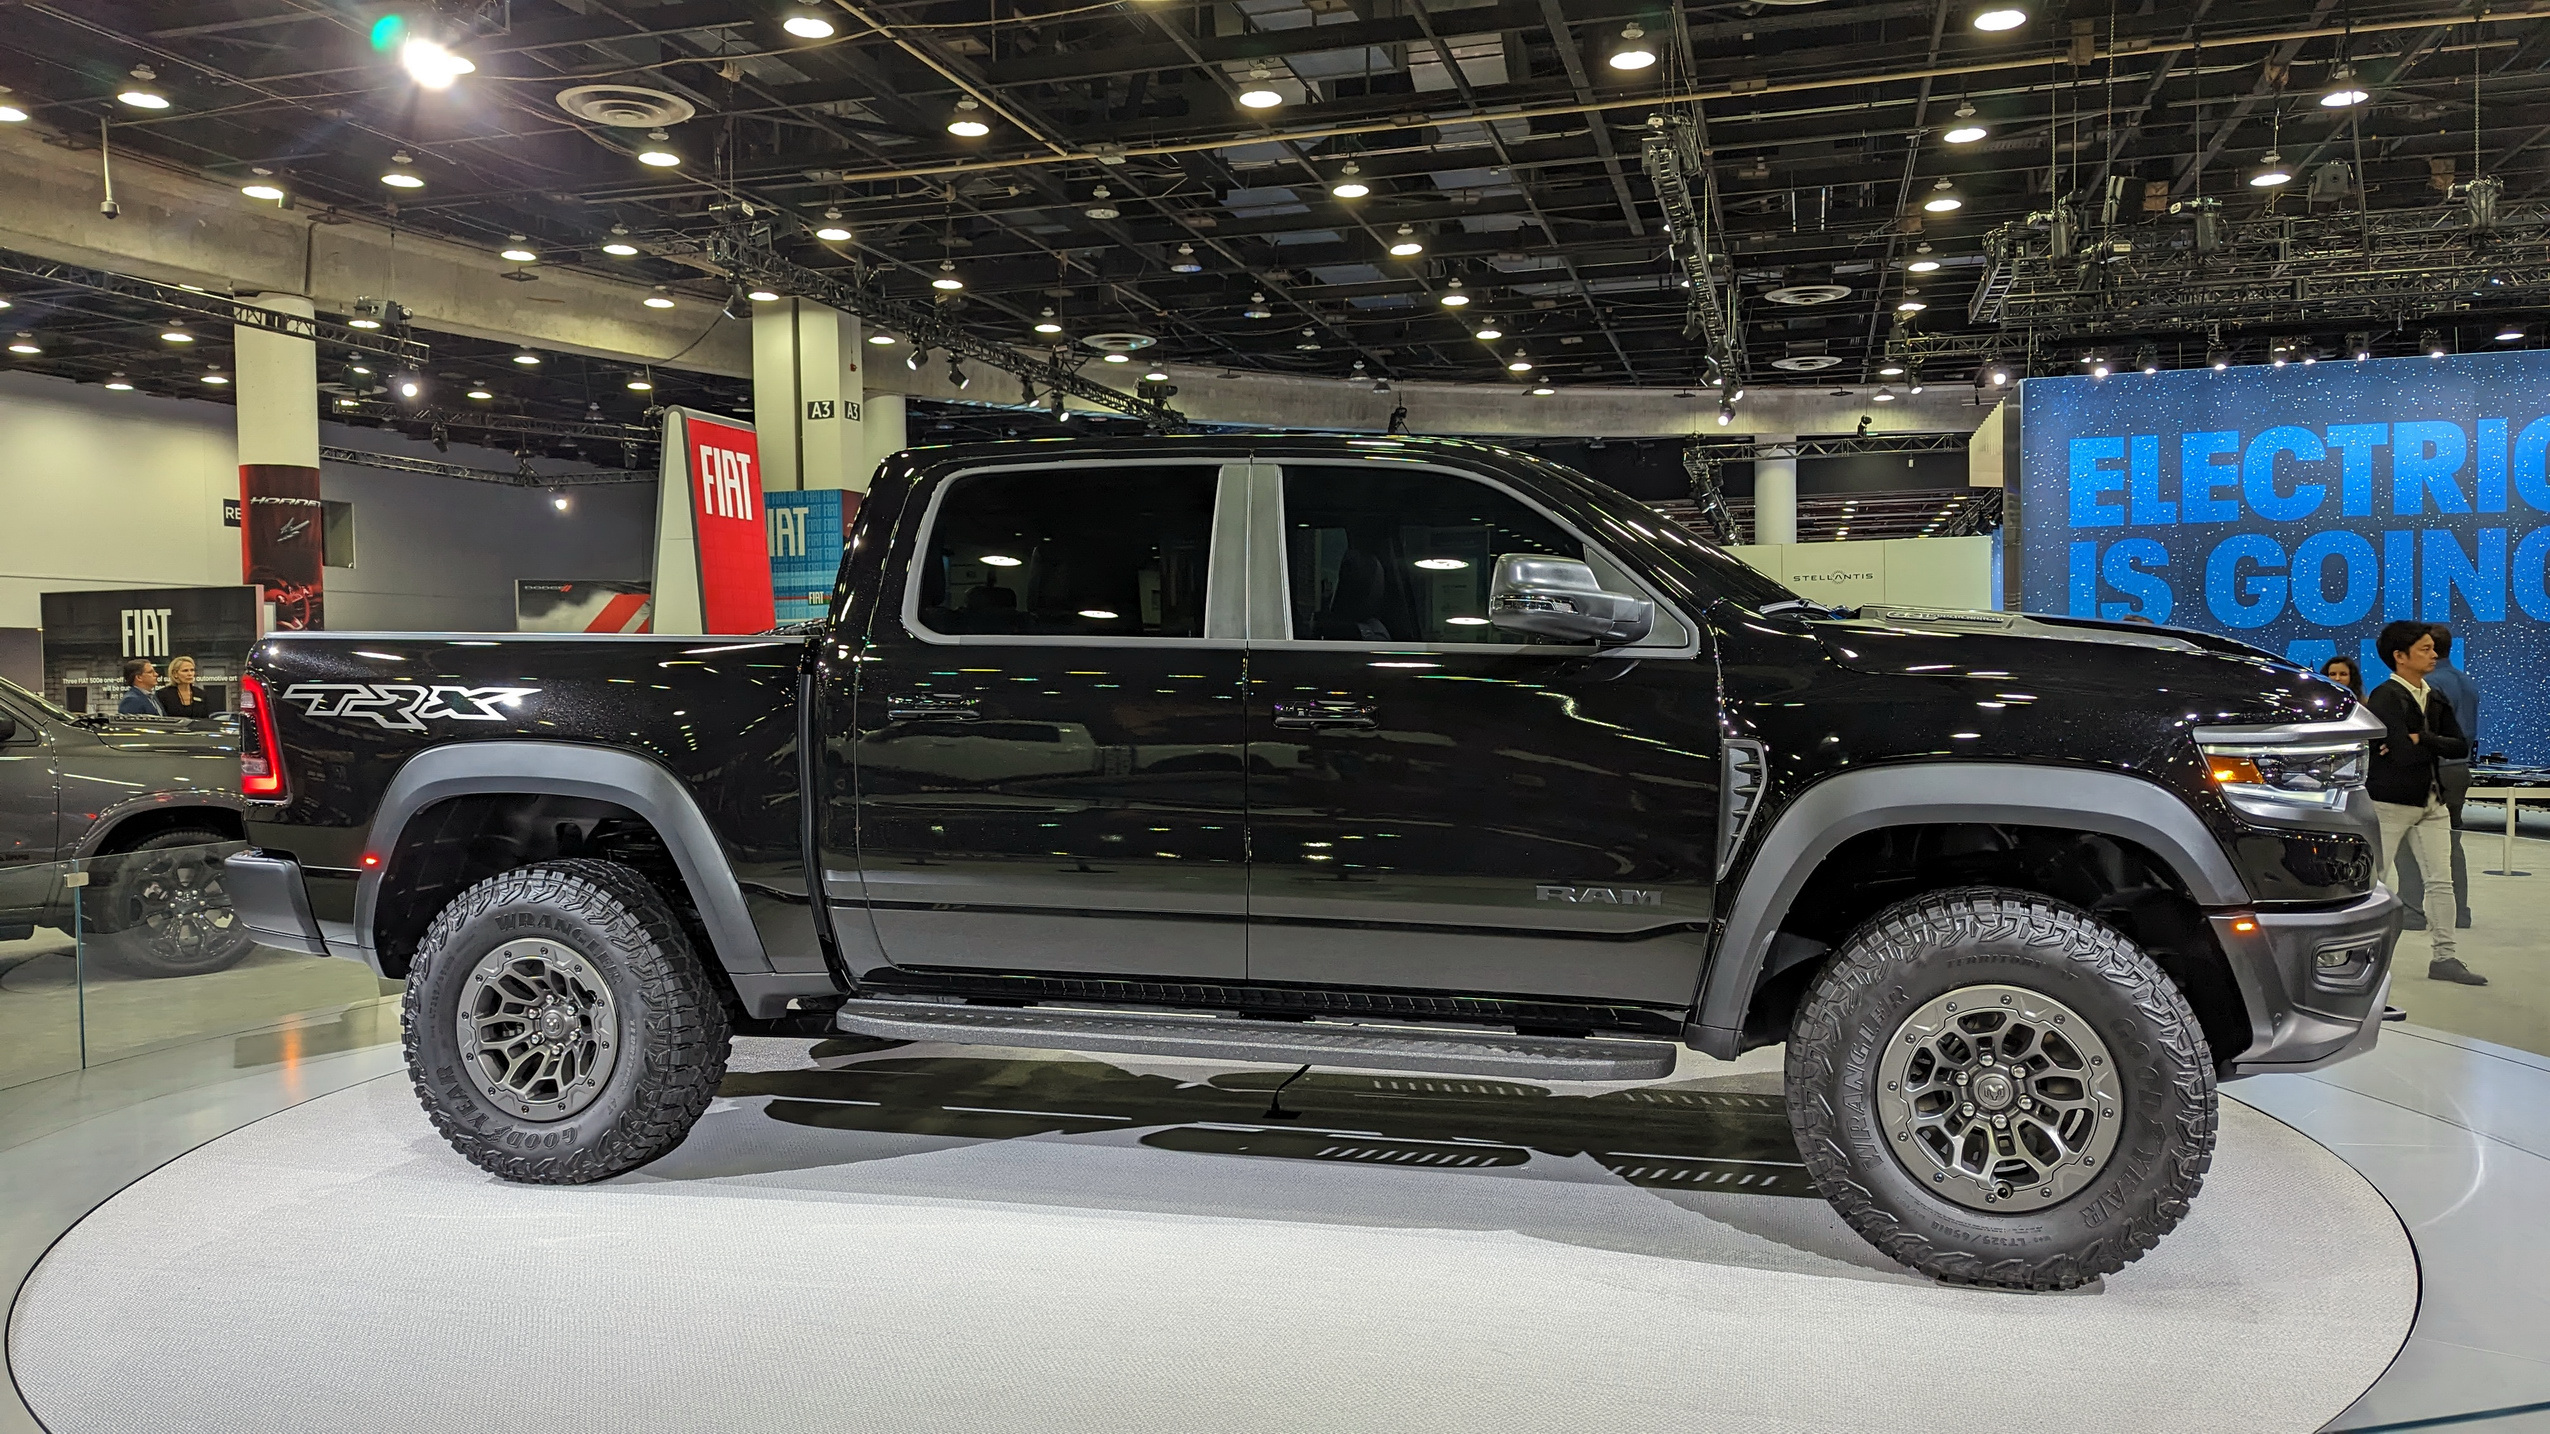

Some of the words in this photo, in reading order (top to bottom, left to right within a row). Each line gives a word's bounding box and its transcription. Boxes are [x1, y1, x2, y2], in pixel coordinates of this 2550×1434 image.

[812, 402, 831, 418] A3
[847, 403, 859, 420] A3
[700, 444, 753, 521] FIAT
[767, 507, 809, 556] IAT
[809, 592, 824, 605] FIAT
[1793, 573, 1873, 581] STELLANTIS
[2069, 537, 2174, 625] IS
[121, 609, 172, 658] FIAT
[282, 684, 542, 731] TRX
[1536, 885, 1663, 907] RAM
[495, 911, 624, 985] WRANGLER
[1843, 985, 1910, 1172] WRANGLER
